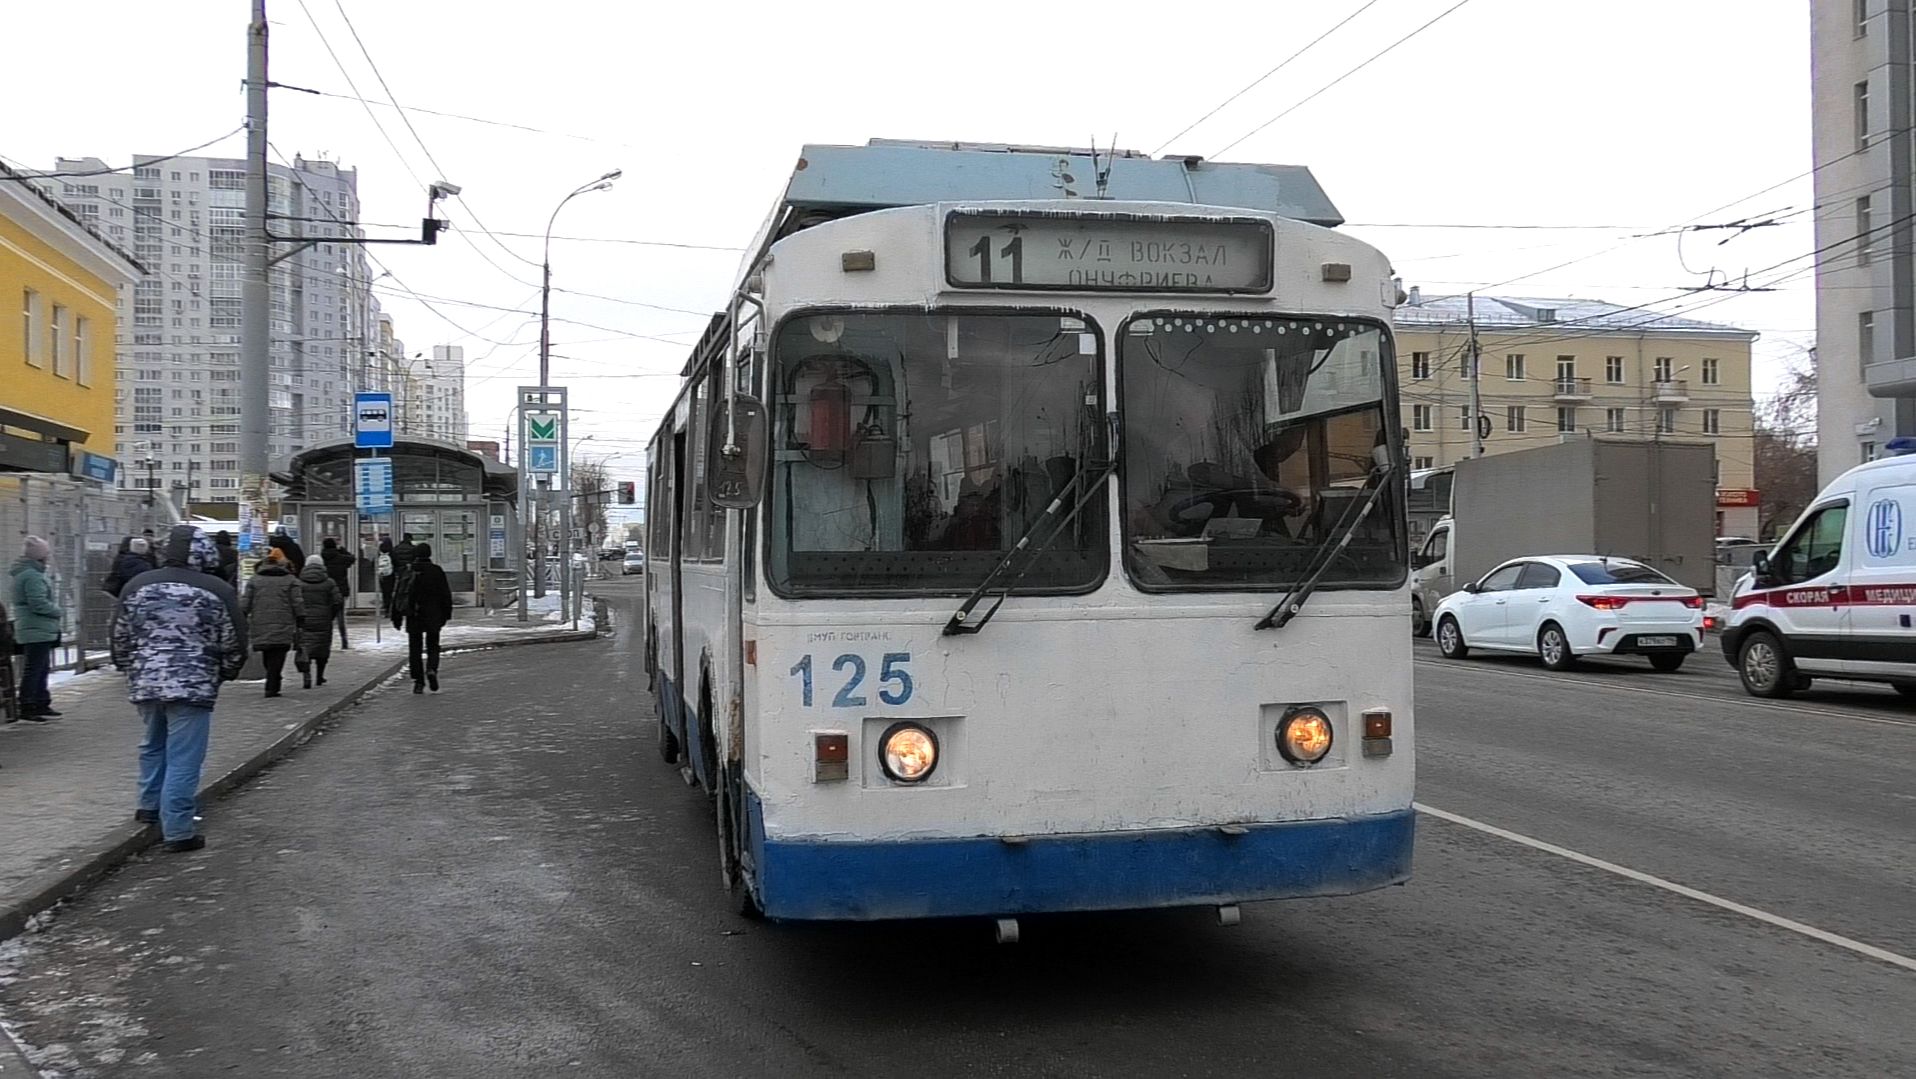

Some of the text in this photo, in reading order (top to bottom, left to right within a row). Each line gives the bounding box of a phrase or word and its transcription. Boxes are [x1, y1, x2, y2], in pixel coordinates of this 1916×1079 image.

[969, 236, 1023, 283] 11
[1057, 238, 1227, 266] Ж/Д ВОКЗАЛ
[1785, 590, 1830, 604] СКОРАЯ
[789, 652, 914, 708] 125
